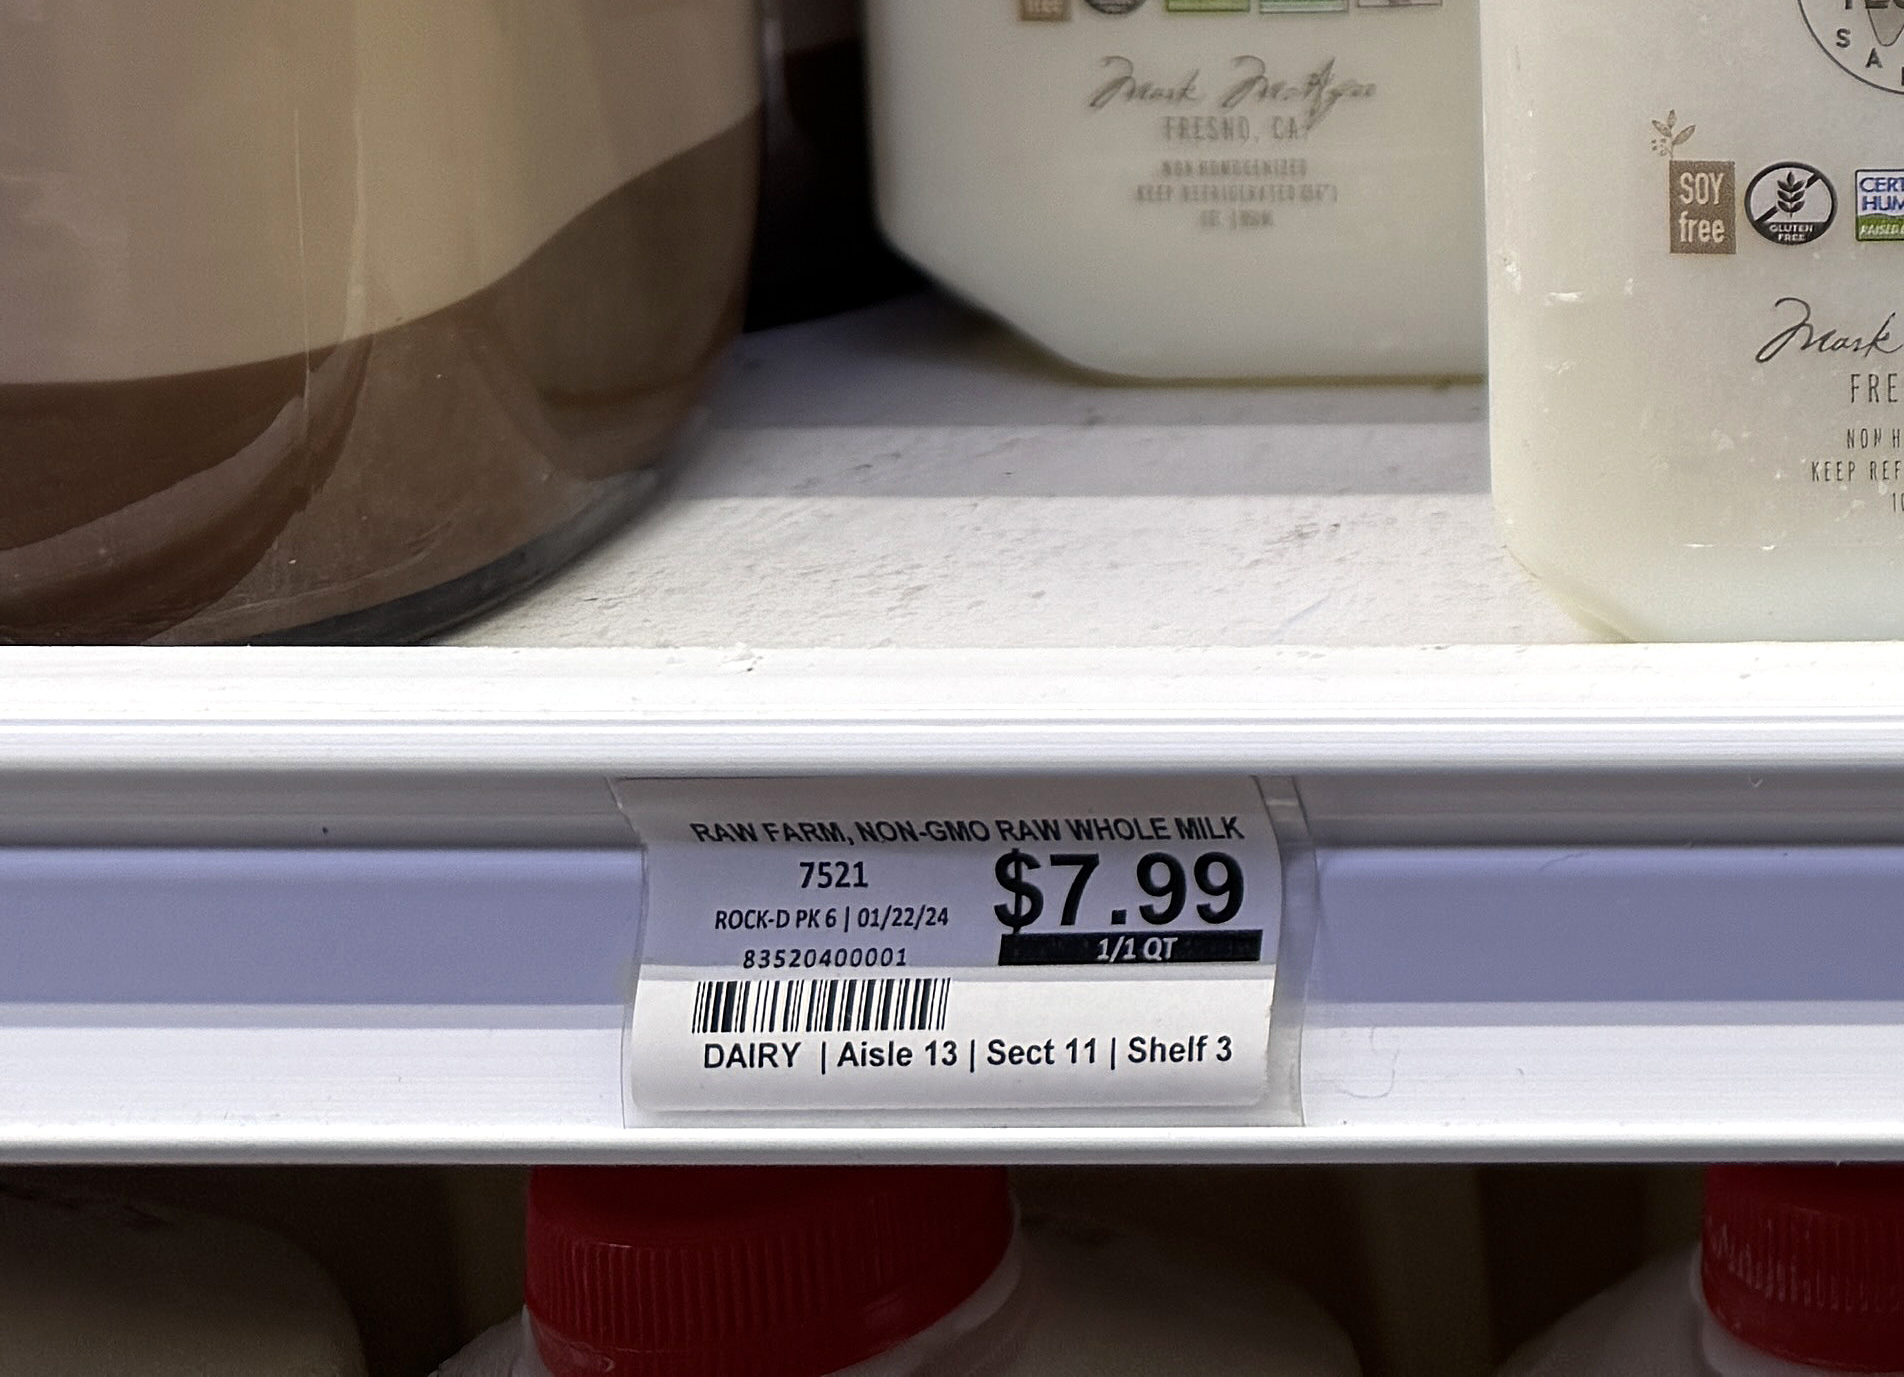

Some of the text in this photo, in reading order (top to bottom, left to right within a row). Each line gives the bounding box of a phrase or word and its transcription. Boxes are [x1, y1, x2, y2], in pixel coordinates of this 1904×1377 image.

[1756, 296, 1903, 364] Mark
[1847, 428, 1883, 450] NON
[691, 817, 1244, 845] RAW FARM, NON-GMO RAW WHOLE MILK
[800, 862, 868, 889] 7521
[994, 848, 1245, 934] $7.99
[715, 906, 949, 930] ROCK-D 01/22/24
[743, 948, 907, 969] 83520400001
[1098, 937, 1177, 962] 1/1 QT
[703, 1035, 1233, 1069] DAIRY Aisle 13 Sect 11 Shelf 3
